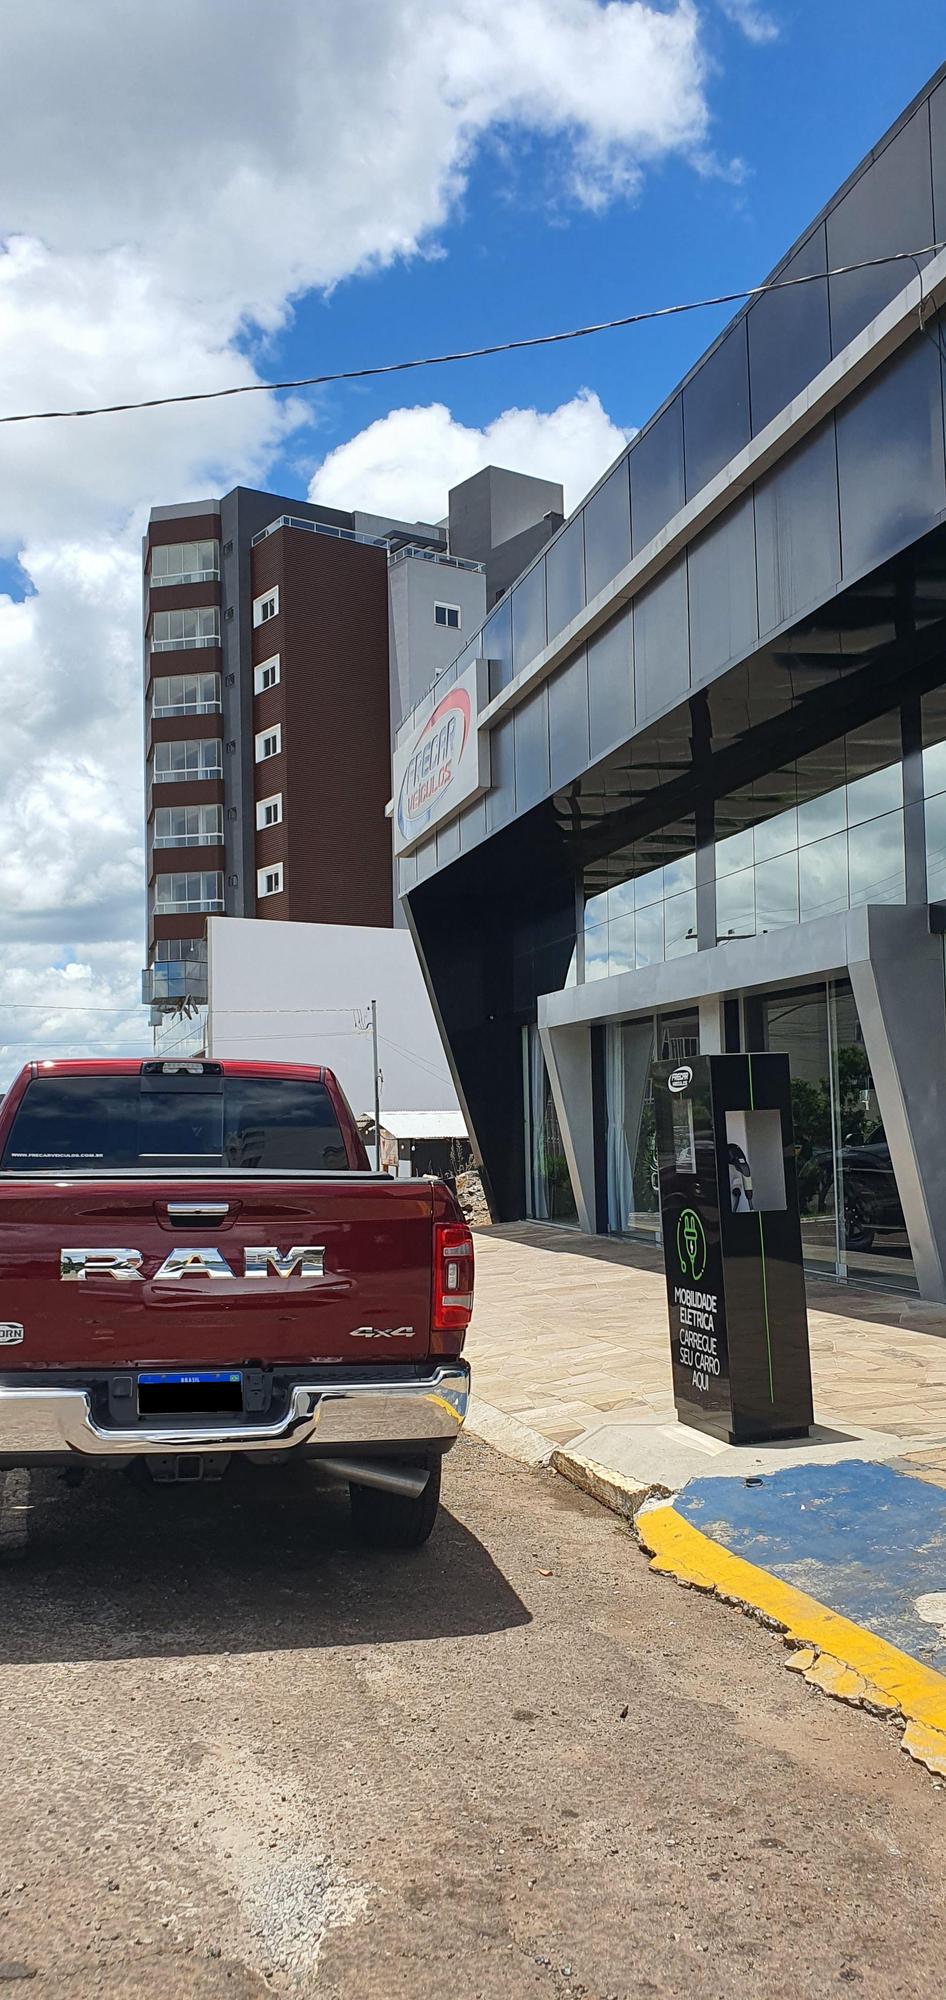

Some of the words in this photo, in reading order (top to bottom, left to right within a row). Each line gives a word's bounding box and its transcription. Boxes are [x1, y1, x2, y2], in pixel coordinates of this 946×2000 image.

[60, 1246, 325, 1281] RAM
[674, 1286, 718, 1313] MOBILIDADE
[679, 1347, 694, 1366] SEU
[694, 1352, 720, 1376] CARRO
[692, 1369, 709, 1392] AQUI
